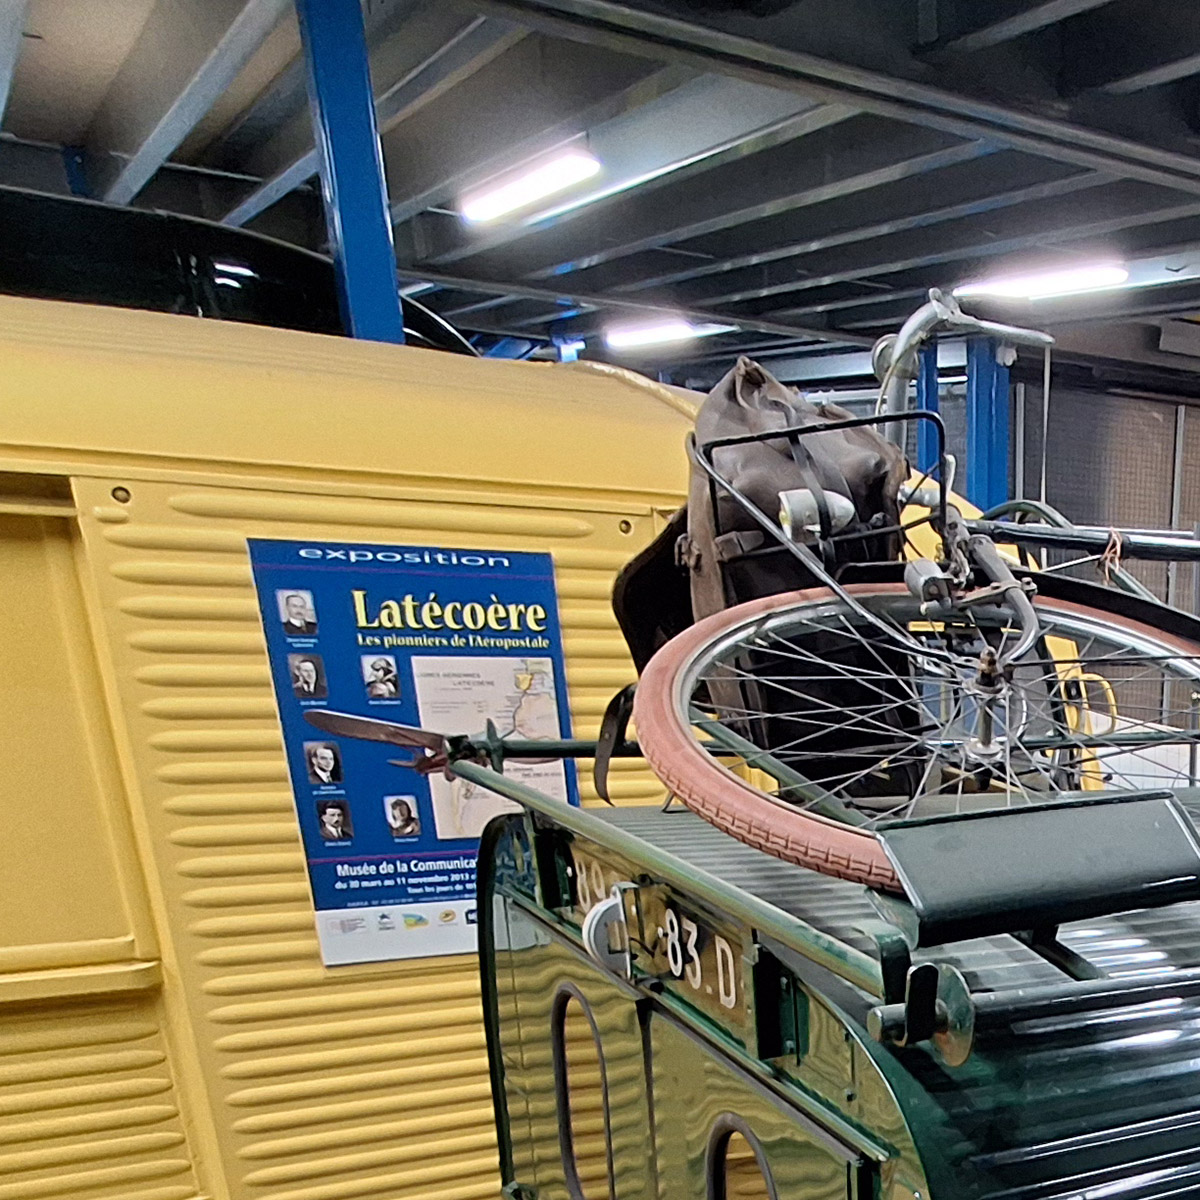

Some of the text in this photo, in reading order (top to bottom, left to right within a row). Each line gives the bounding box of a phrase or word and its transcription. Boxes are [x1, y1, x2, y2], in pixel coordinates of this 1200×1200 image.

[298, 547, 510, 567] exposition
[351, 590, 548, 631] Latécoère
[356, 632, 381, 646] Les
[383, 633, 448, 649] pionniers
[450, 633, 466, 647] de
[336, 855, 478, 877] Musée de la Communica
